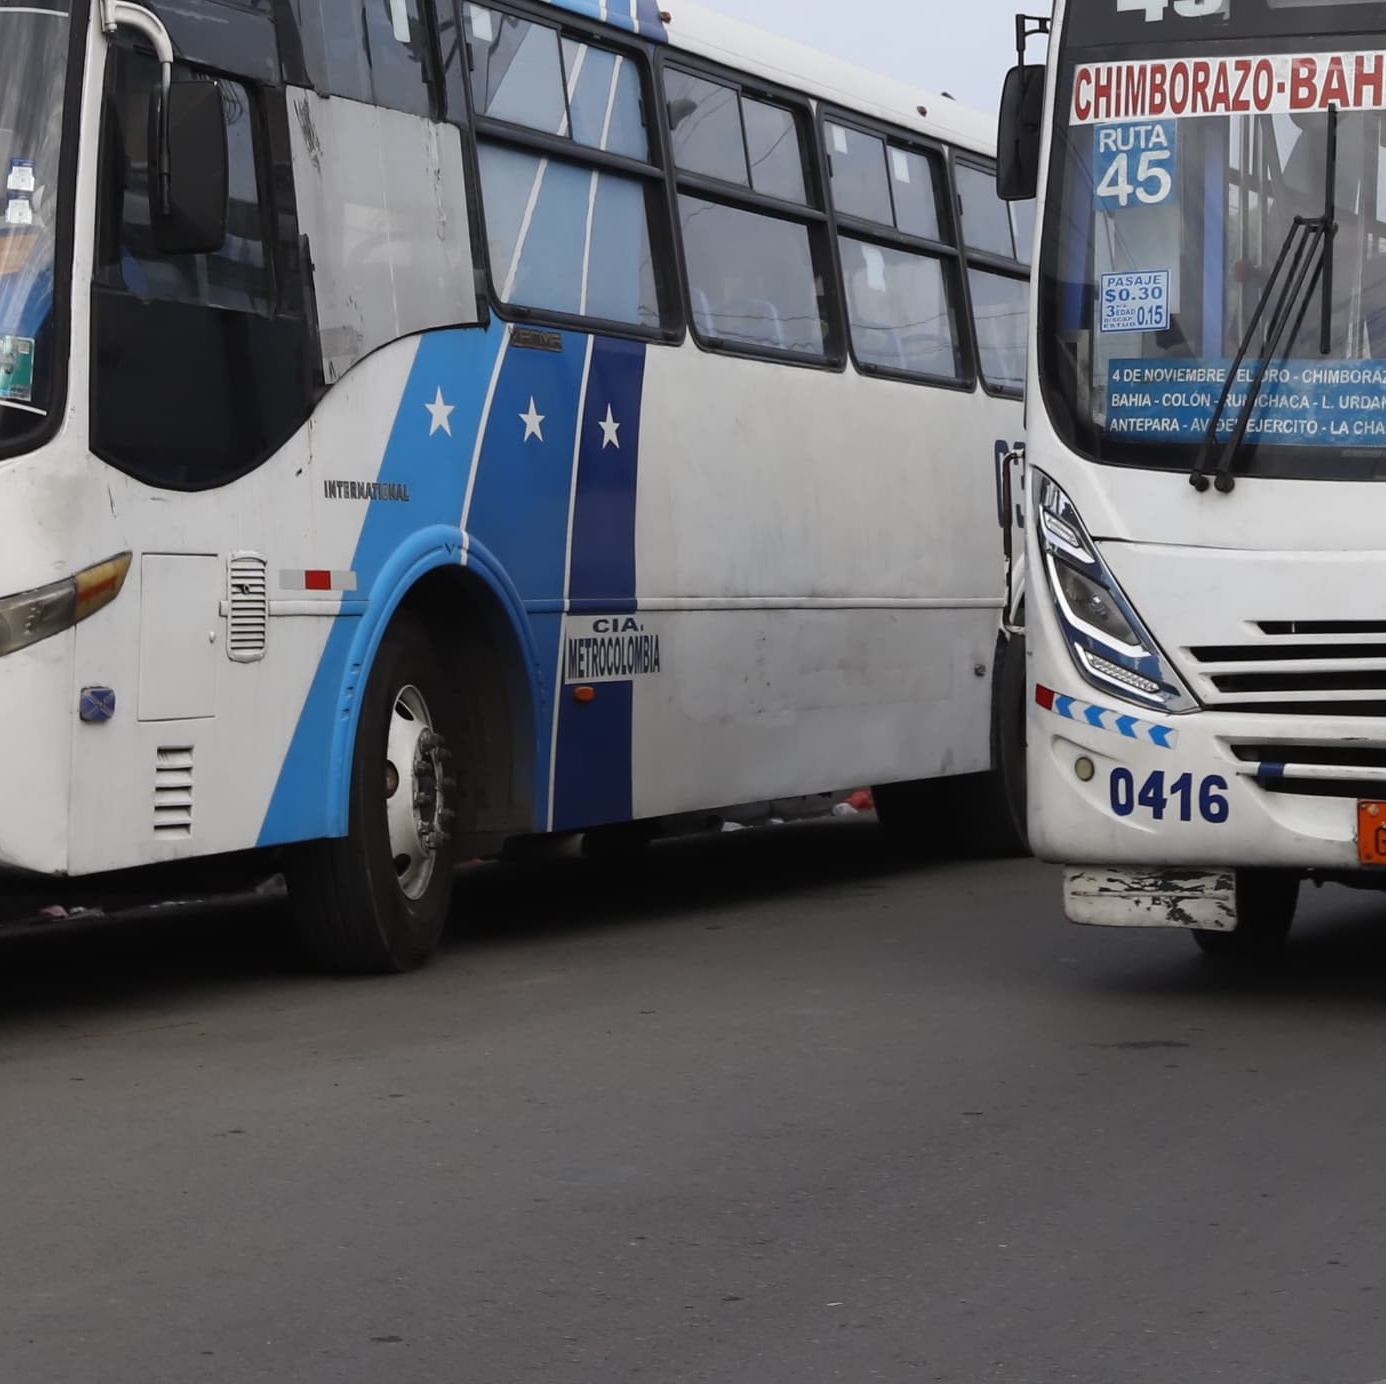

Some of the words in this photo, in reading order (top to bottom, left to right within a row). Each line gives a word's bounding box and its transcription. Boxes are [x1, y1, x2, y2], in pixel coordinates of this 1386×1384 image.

[1099, 123, 1168, 153] RUTA
[1096, 150, 1171, 206] 45
[1107, 275, 1162, 287] PASAJE
[1105, 287, 1163, 303] $0.30
[1112, 368, 1120, 382] 4
[1123, 368, 1141, 382] DE
[1144, 368, 1226, 383] NOVIEMBRE
[1237, 368, 1254, 383] EL
[1111, 393, 1151, 407] BAHIA
[1162, 390, 1211, 407] COLÓN
[1322, 395, 1334, 409] L.
[1110, 418, 1180, 432] ANTEPARA
[1245, 419, 1318, 434] EJERCITO
[1330, 421, 1350, 435] LA
[324, 480, 410, 502] INTERNATIONAL
[593, 617, 644, 633] CIA.
[568, 634, 661, 679] METROCOLOMBIA
[1109, 767, 1229, 823] 0416
